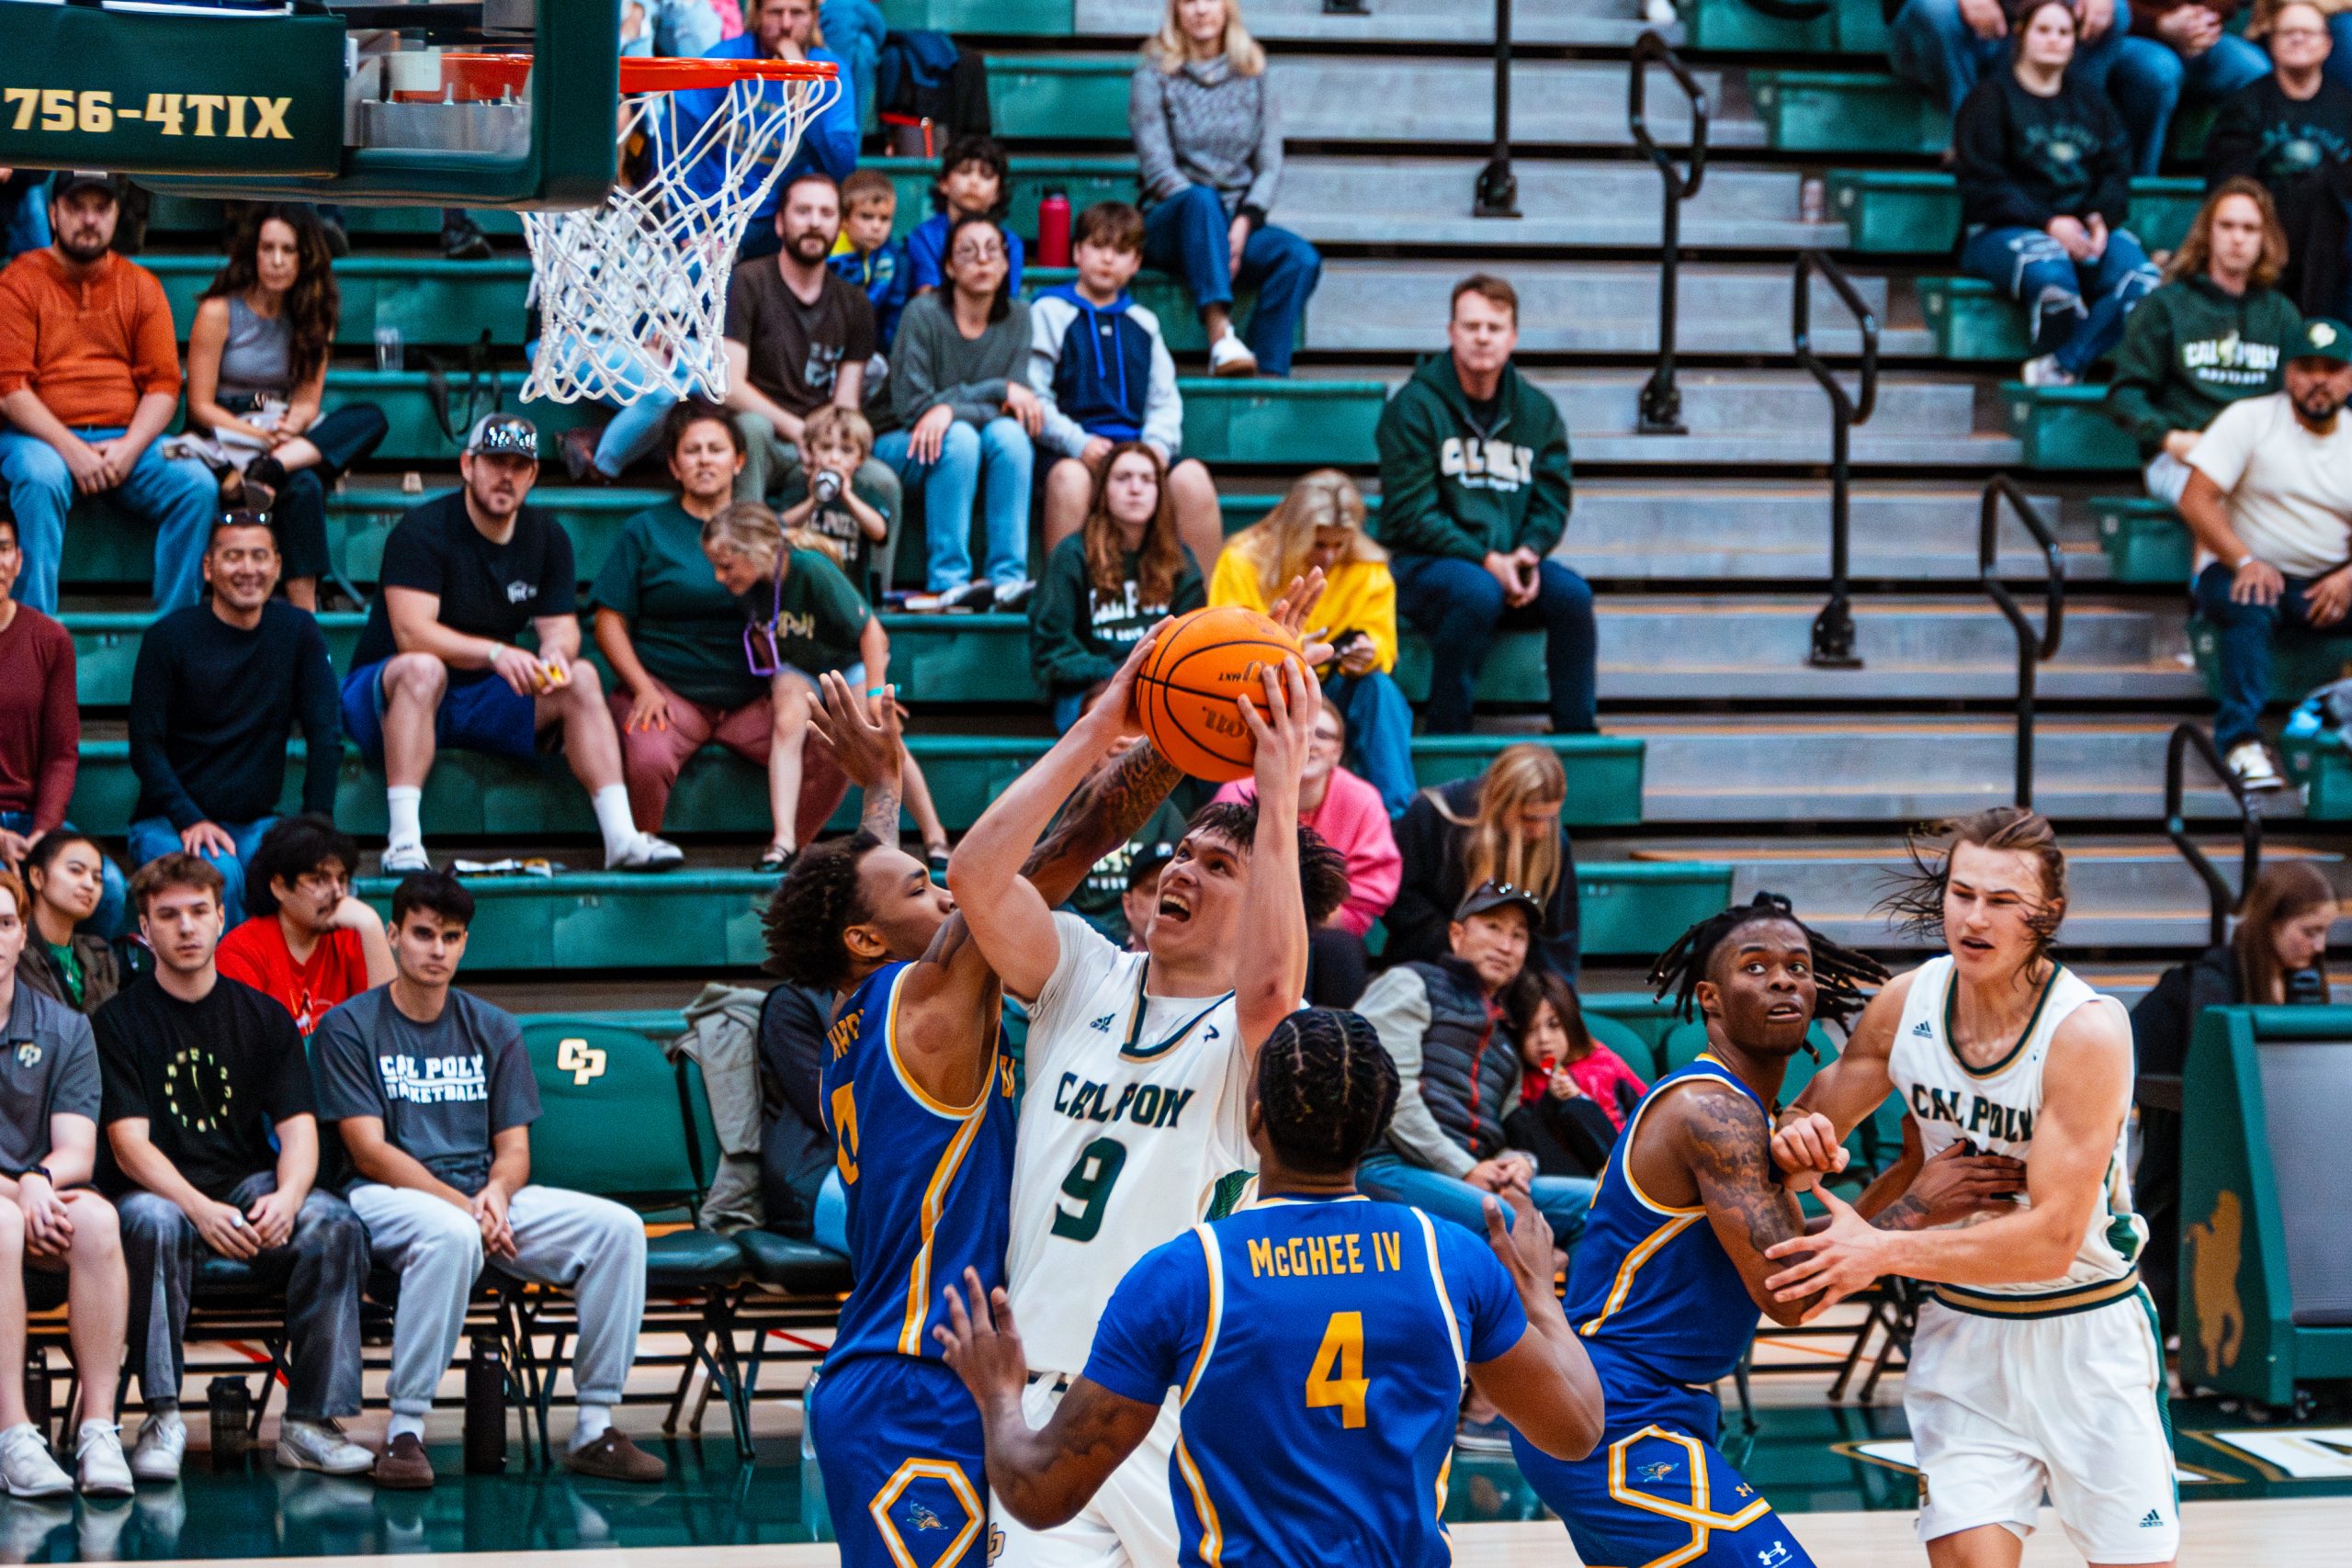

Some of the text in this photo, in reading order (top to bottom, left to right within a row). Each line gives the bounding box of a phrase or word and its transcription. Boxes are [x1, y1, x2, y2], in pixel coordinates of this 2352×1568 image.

[4, 88, 294, 139] 756-4TIX
[379, 1054, 484, 1079] CAL POLY
[557, 1037, 607, 1086] CP
[385, 1083, 488, 1104] BAKETBALL
[1912, 1083, 1964, 1127] CAL
[1050, 1136, 1127, 1244] 9
[1247, 1231, 1401, 1279] McGHEE IV
[1305, 1311, 1371, 1429] 4
